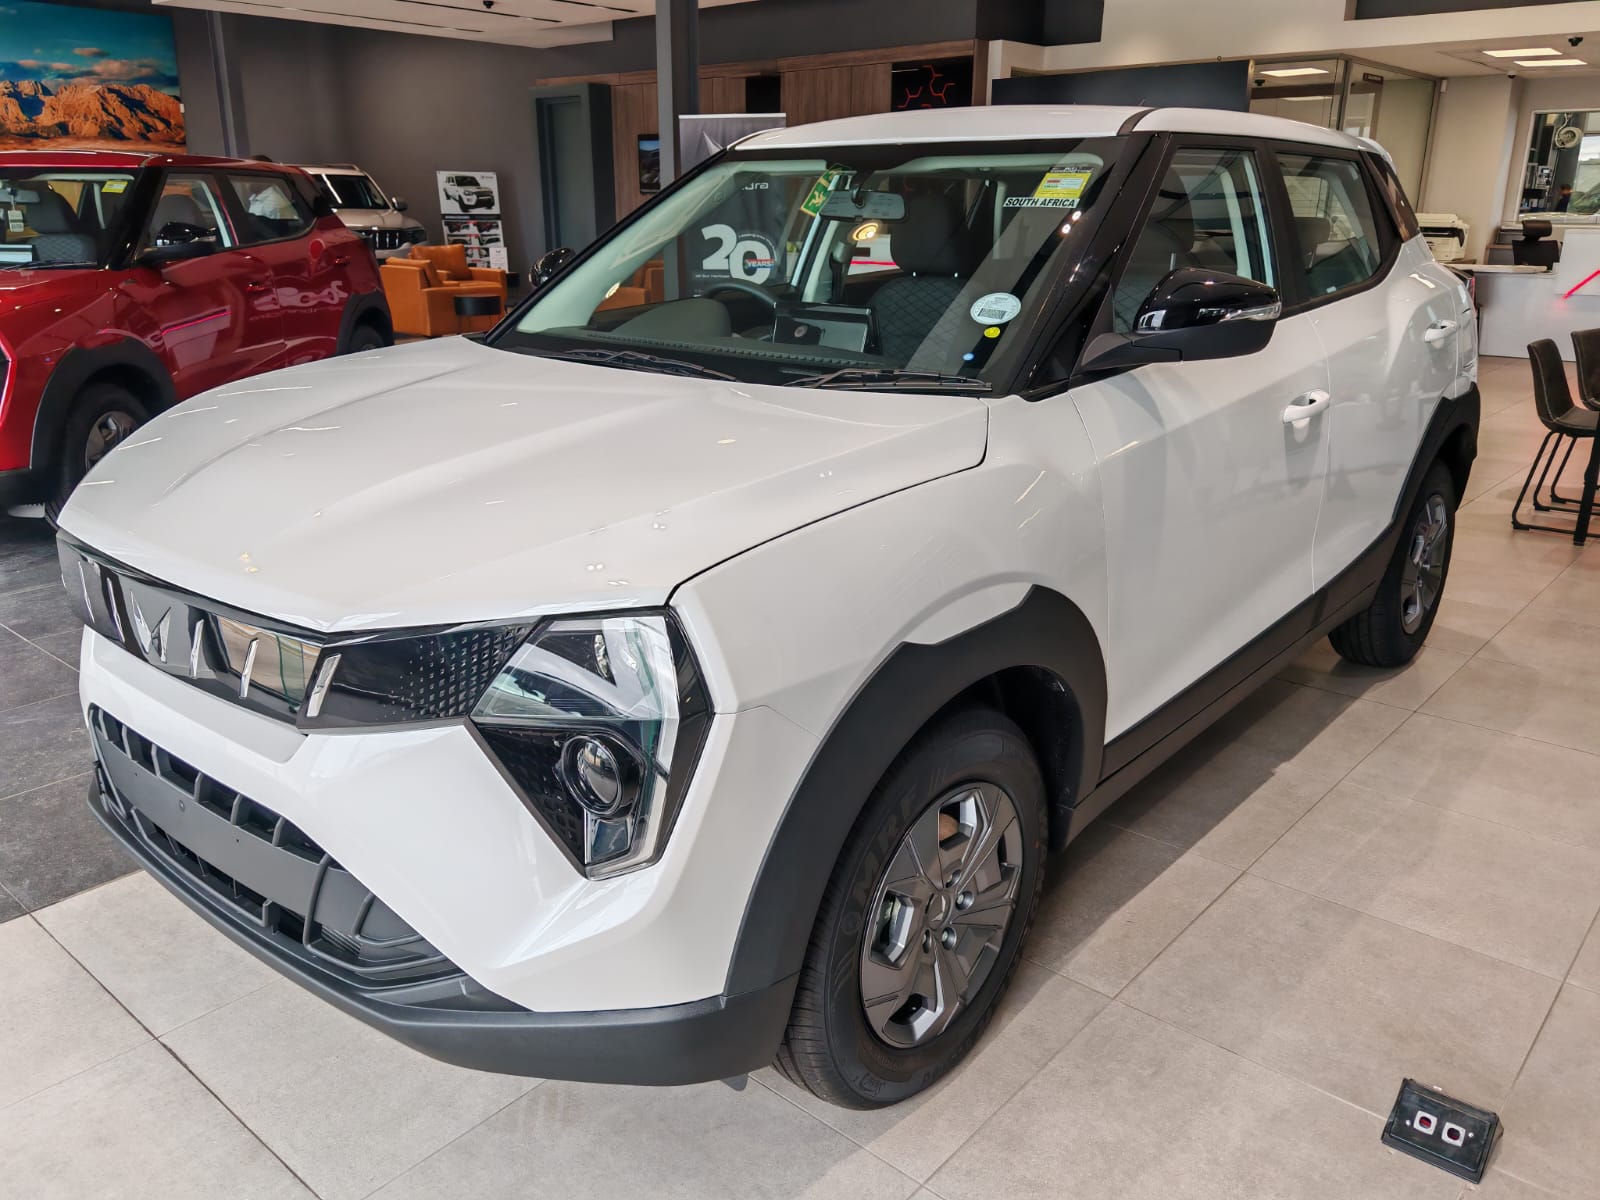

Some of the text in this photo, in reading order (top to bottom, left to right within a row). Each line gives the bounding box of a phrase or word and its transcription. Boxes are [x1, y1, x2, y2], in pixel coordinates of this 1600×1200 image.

[1005, 198, 1075, 207] SOUTH AFRICA
[701, 223, 771, 285] 20
